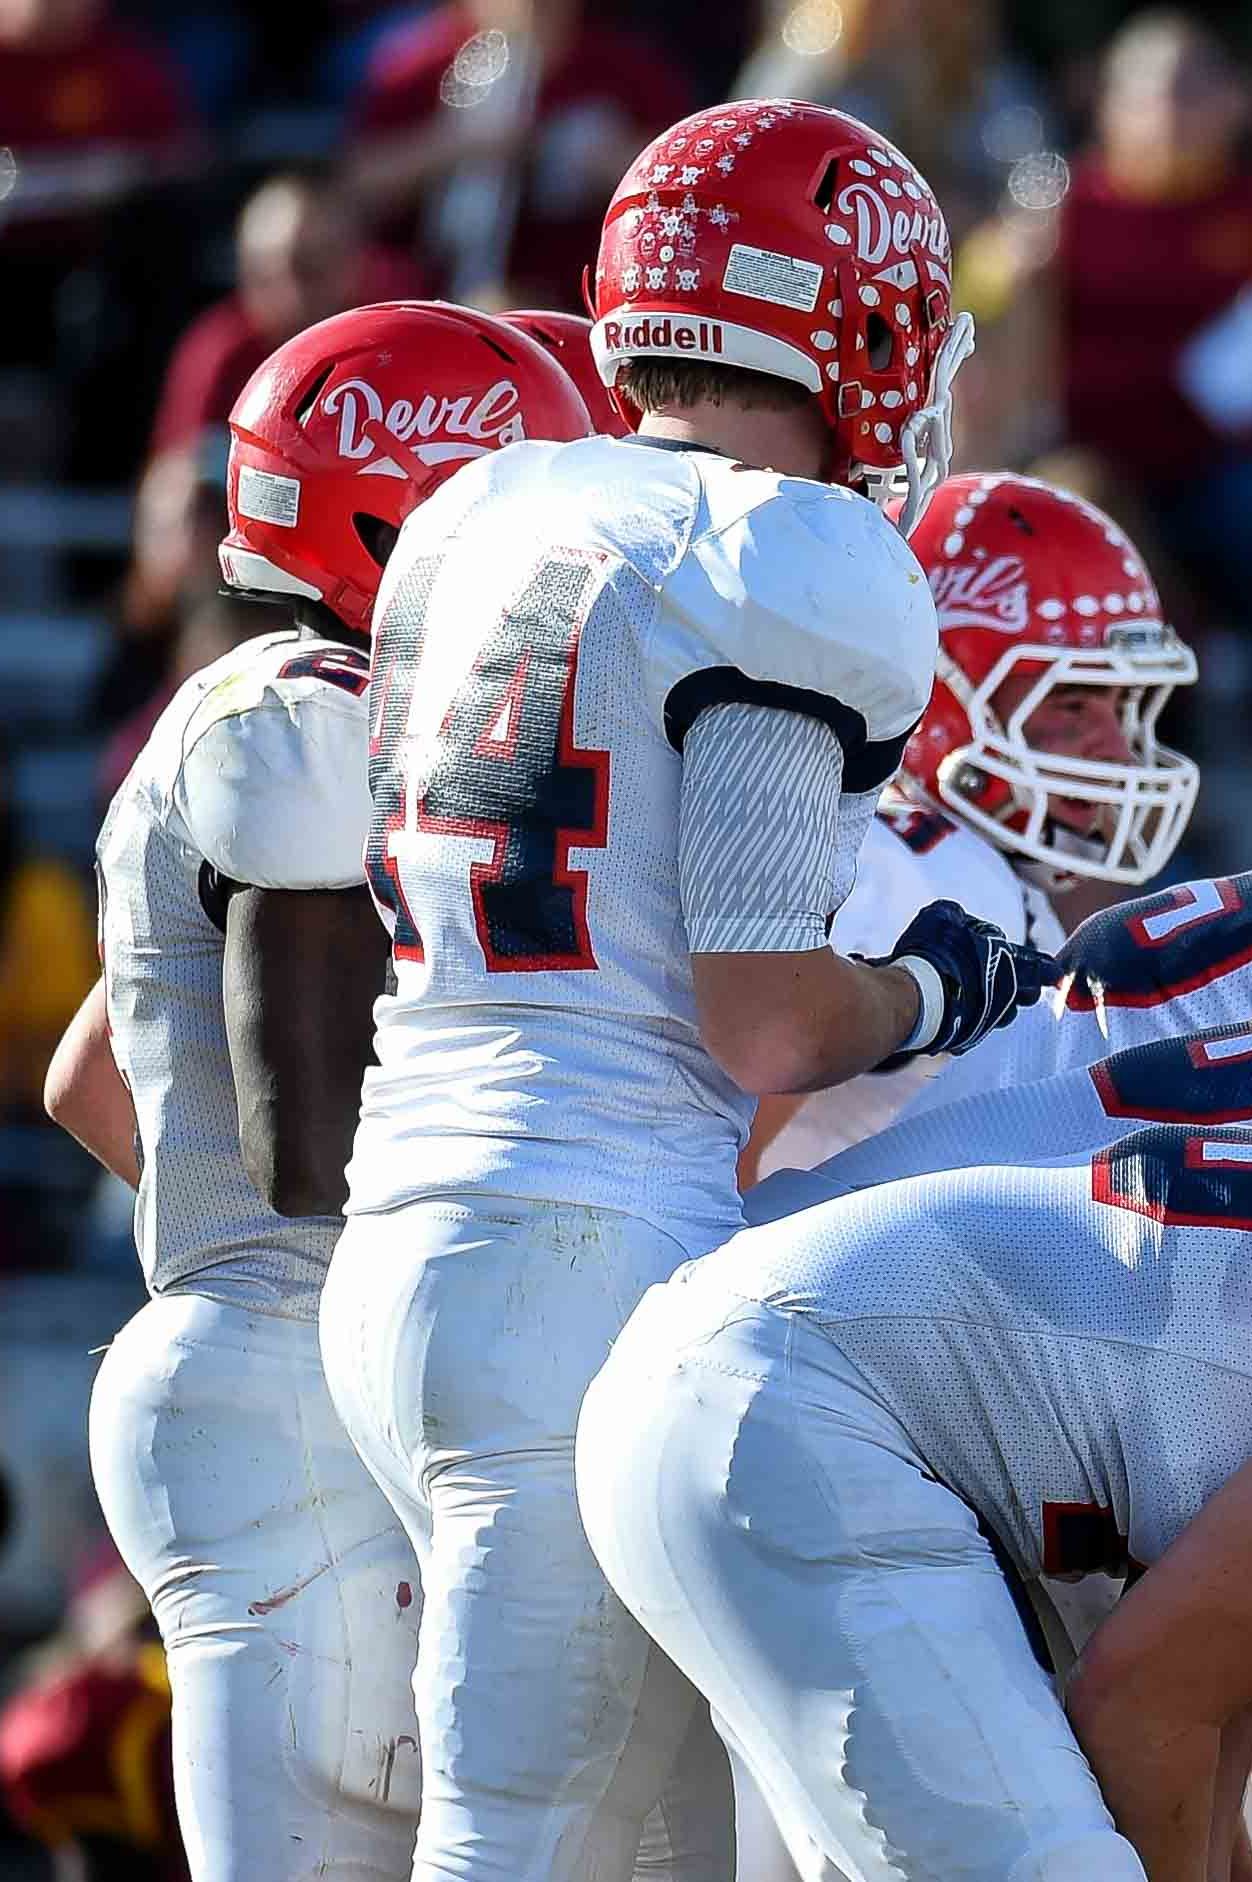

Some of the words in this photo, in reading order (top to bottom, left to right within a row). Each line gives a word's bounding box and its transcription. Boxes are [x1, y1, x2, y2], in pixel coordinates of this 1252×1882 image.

[604, 318, 723, 354] Riddell
[322, 378, 526, 460] Devils
[929, 549, 1028, 624] vils
